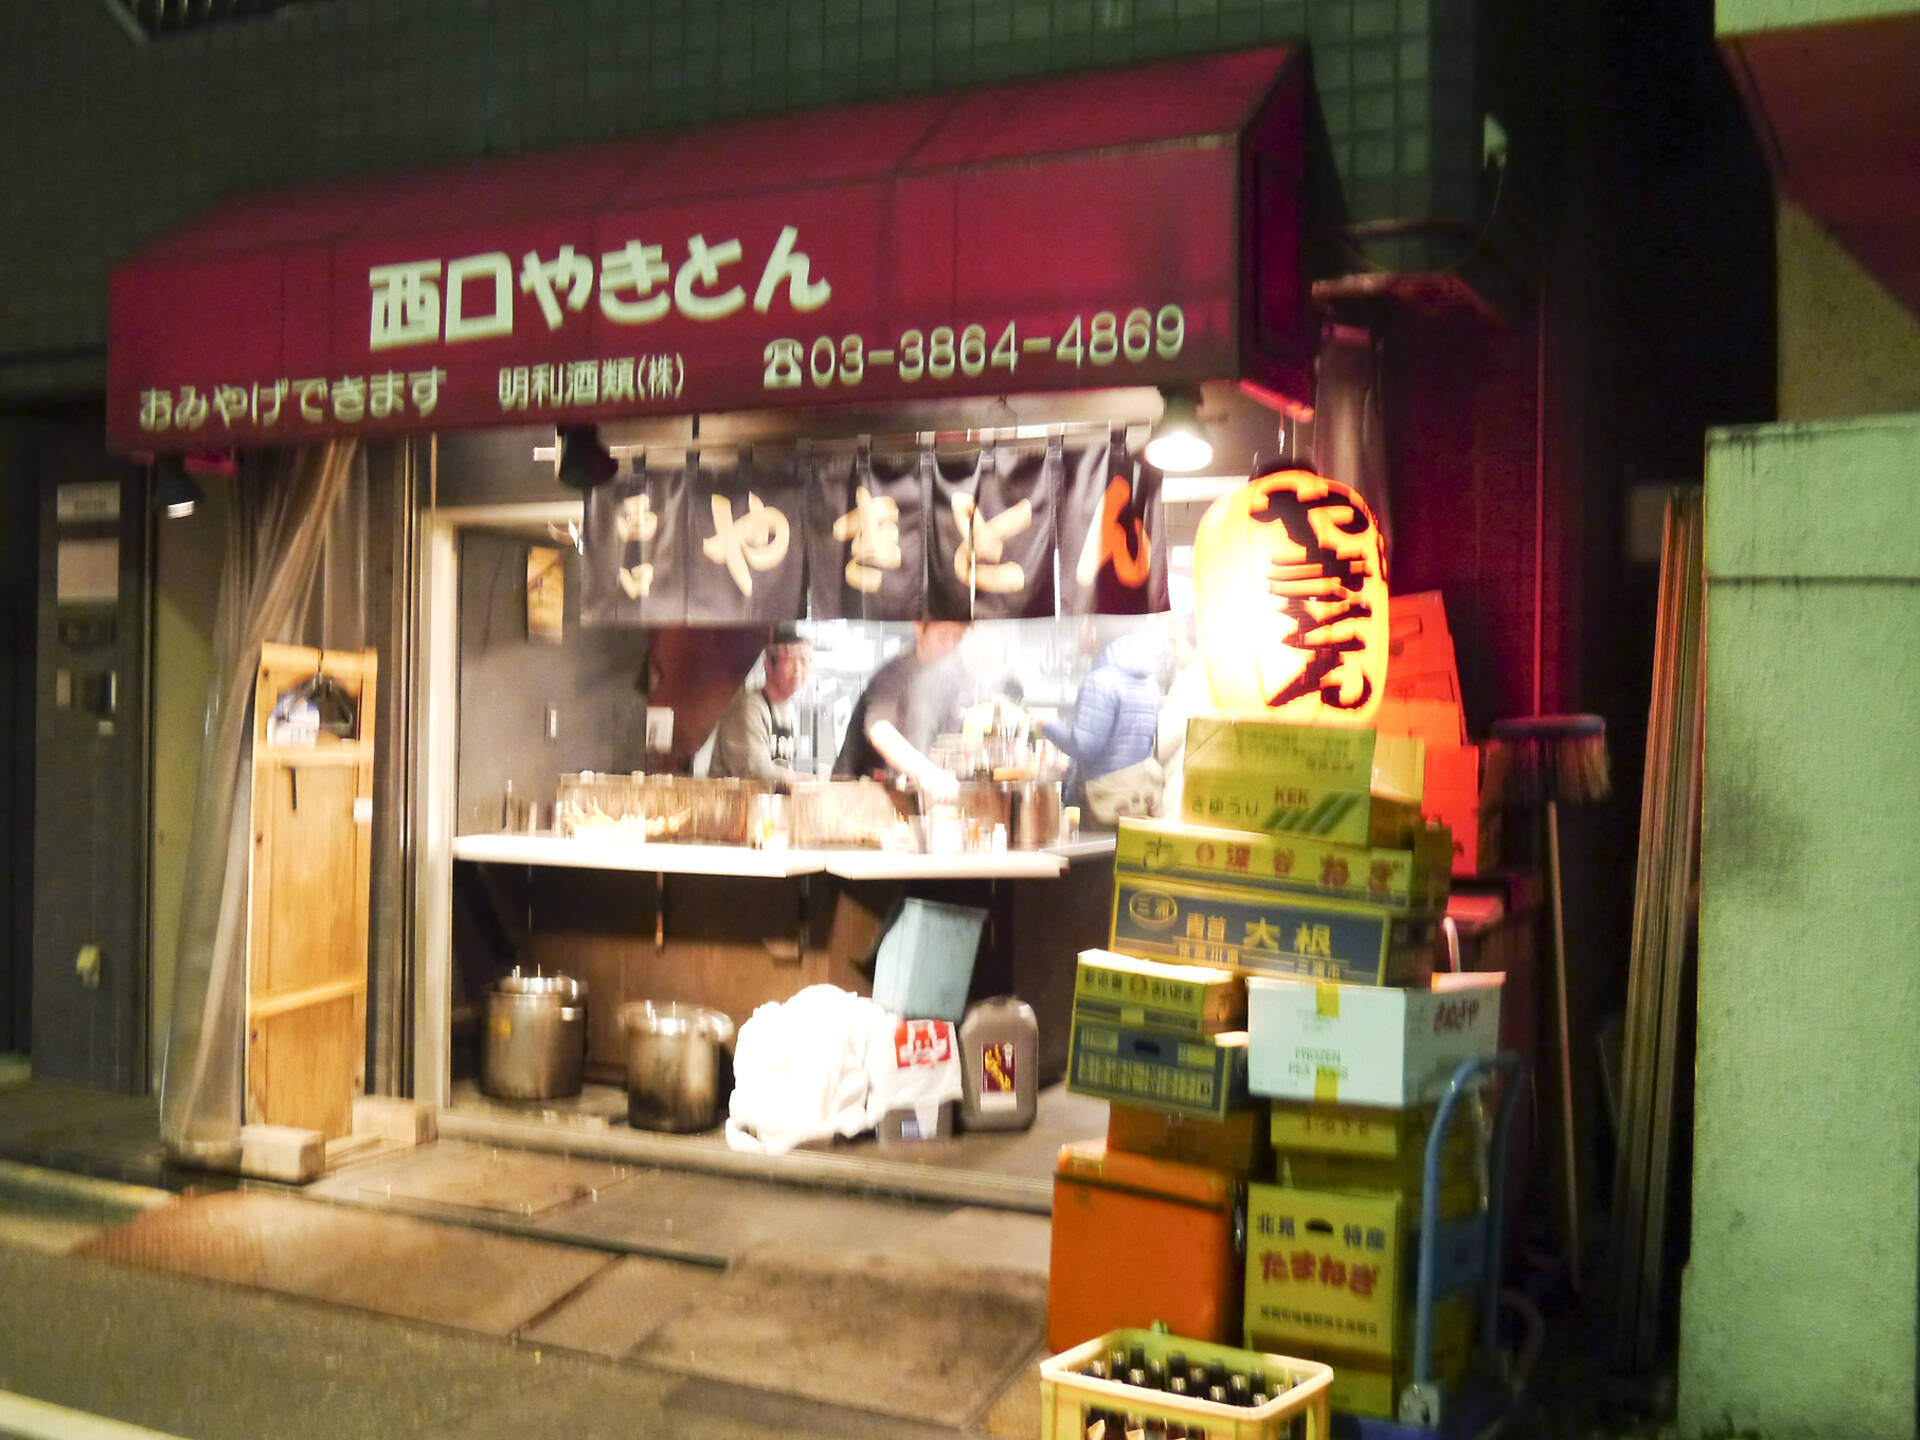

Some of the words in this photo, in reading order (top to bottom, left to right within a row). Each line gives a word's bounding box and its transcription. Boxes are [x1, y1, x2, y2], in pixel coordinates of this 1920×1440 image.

[369, 225, 831, 351] 西口やきとん
[498, 351, 684, 412] 明利酒類(株)
[810, 304, 1185, 388] 03-3864-4869
[140, 366, 447, 432] おみやげできます
